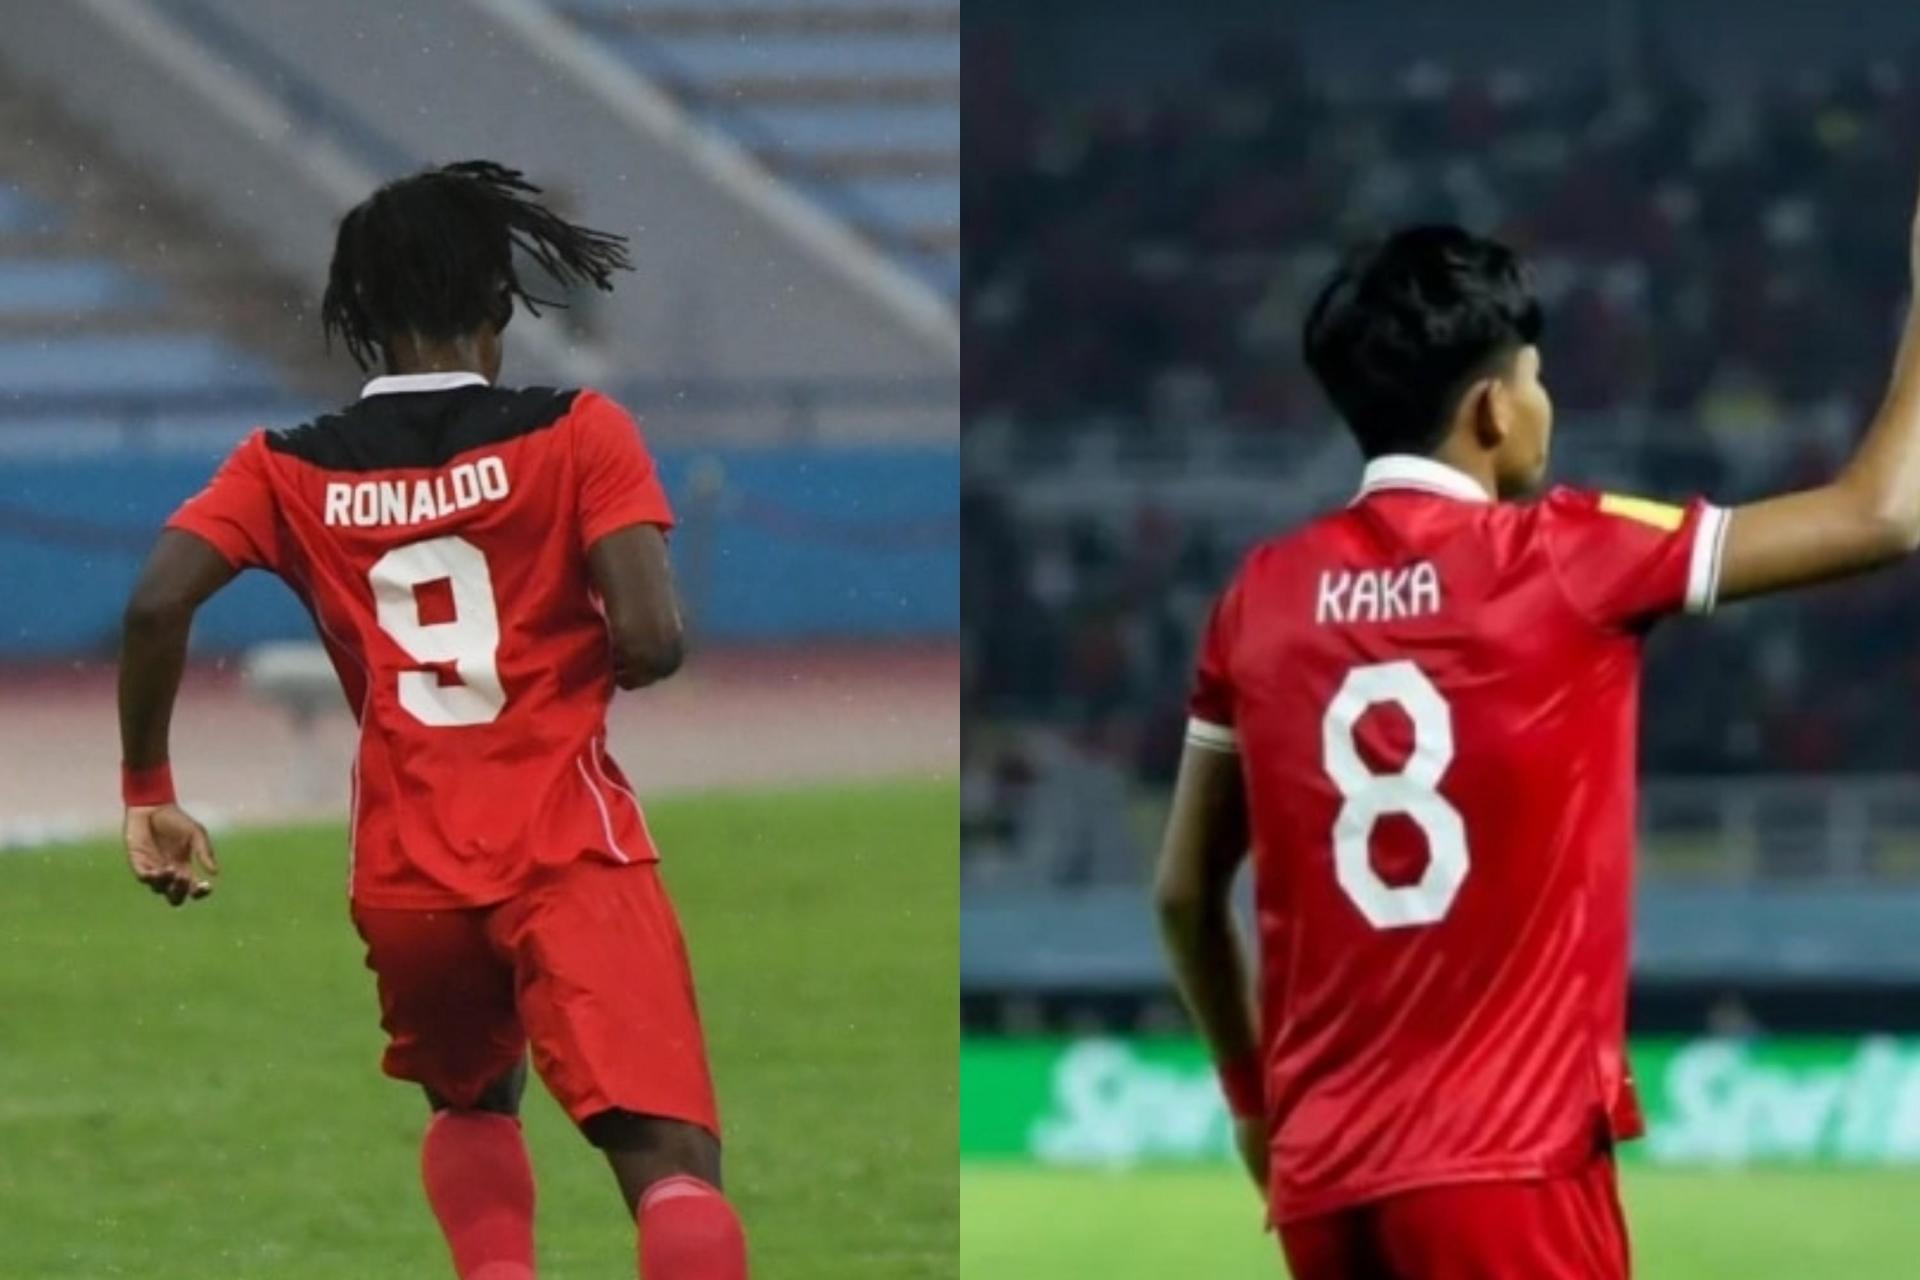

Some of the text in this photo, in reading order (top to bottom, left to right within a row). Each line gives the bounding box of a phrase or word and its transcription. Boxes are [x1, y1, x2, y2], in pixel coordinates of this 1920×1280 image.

[325, 456, 510, 526] RONALDO
[368, 536, 506, 727] 9
[1316, 560, 1440, 625] KAKA
[1322, 660, 1470, 929] 8
